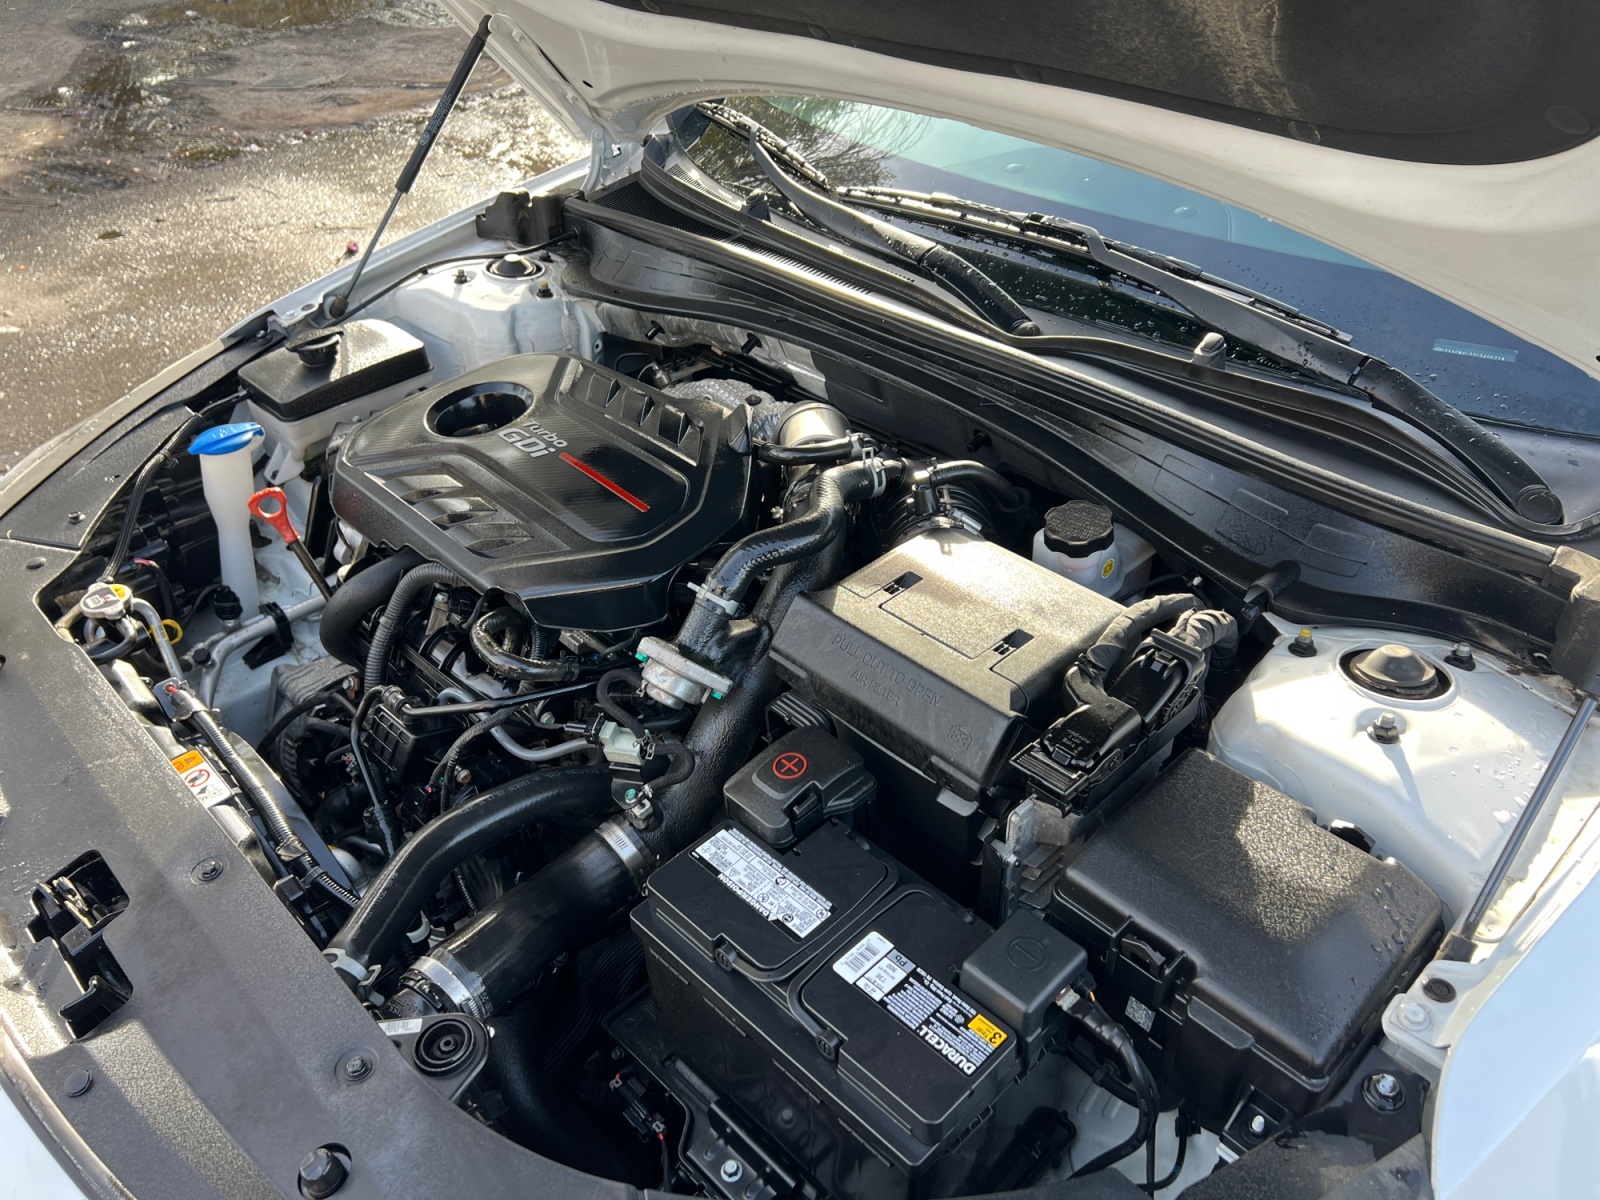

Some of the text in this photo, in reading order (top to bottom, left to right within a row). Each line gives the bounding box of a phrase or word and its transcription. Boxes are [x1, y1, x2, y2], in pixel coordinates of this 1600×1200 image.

[498, 428, 556, 458] GDi
[523, 419, 568, 448] Turbo
[832, 633, 943, 707] PULL OUT TO OPEN
[850, 669, 902, 707] AIR FILTER
[716, 872, 771, 916] DANGER/POISON
[895, 954, 908, 967] Pb
[916, 1024, 977, 1076] DURACELL
[989, 1031, 1002, 1045] 3
